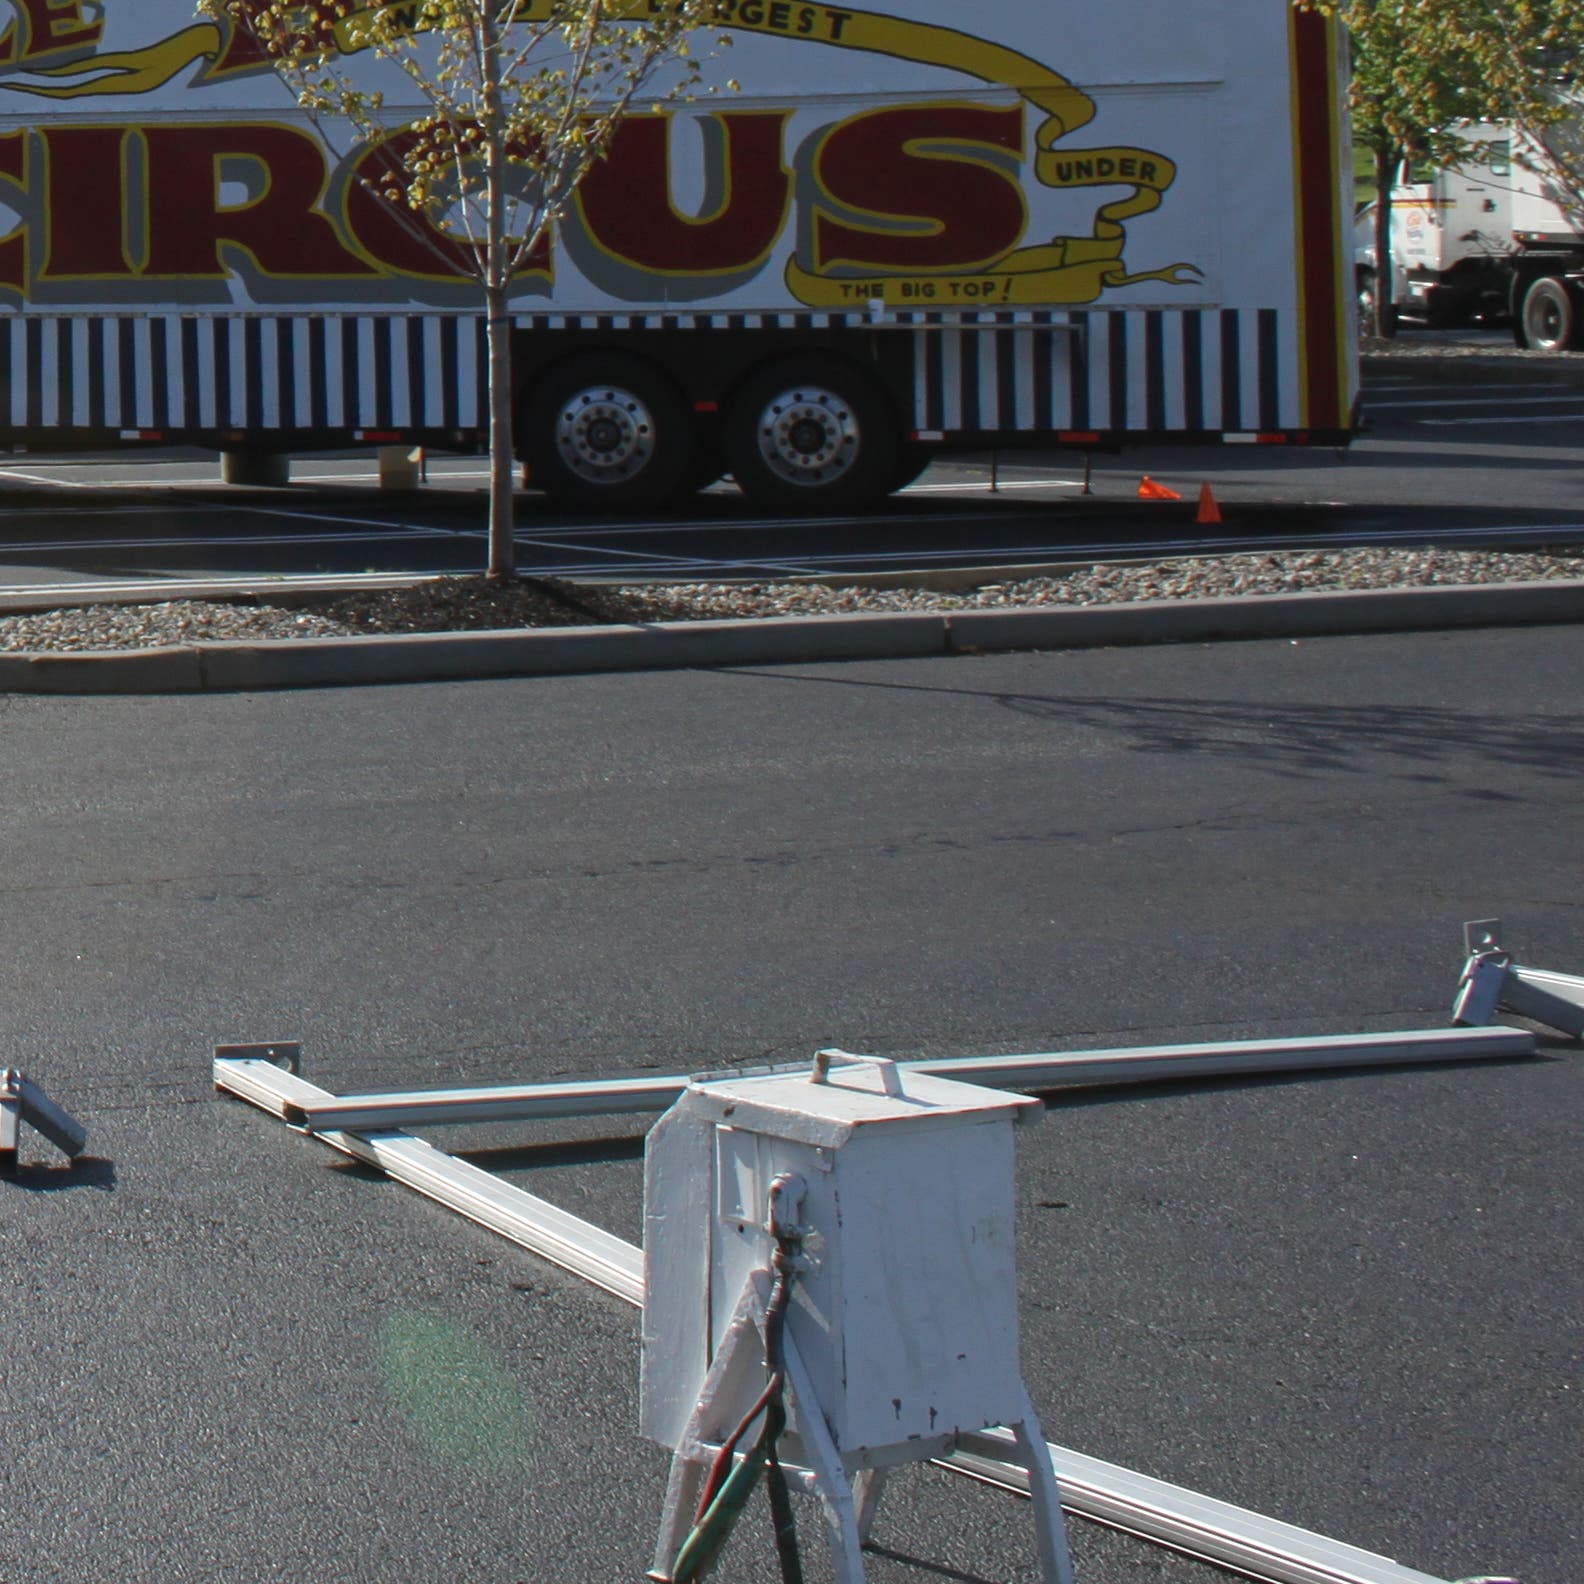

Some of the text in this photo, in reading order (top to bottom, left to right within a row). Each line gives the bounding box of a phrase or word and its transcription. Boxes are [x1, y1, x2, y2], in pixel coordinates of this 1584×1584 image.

[1054, 156, 1158, 183] UNDER
[840, 277, 1013, 302] THE BIG TOP!
